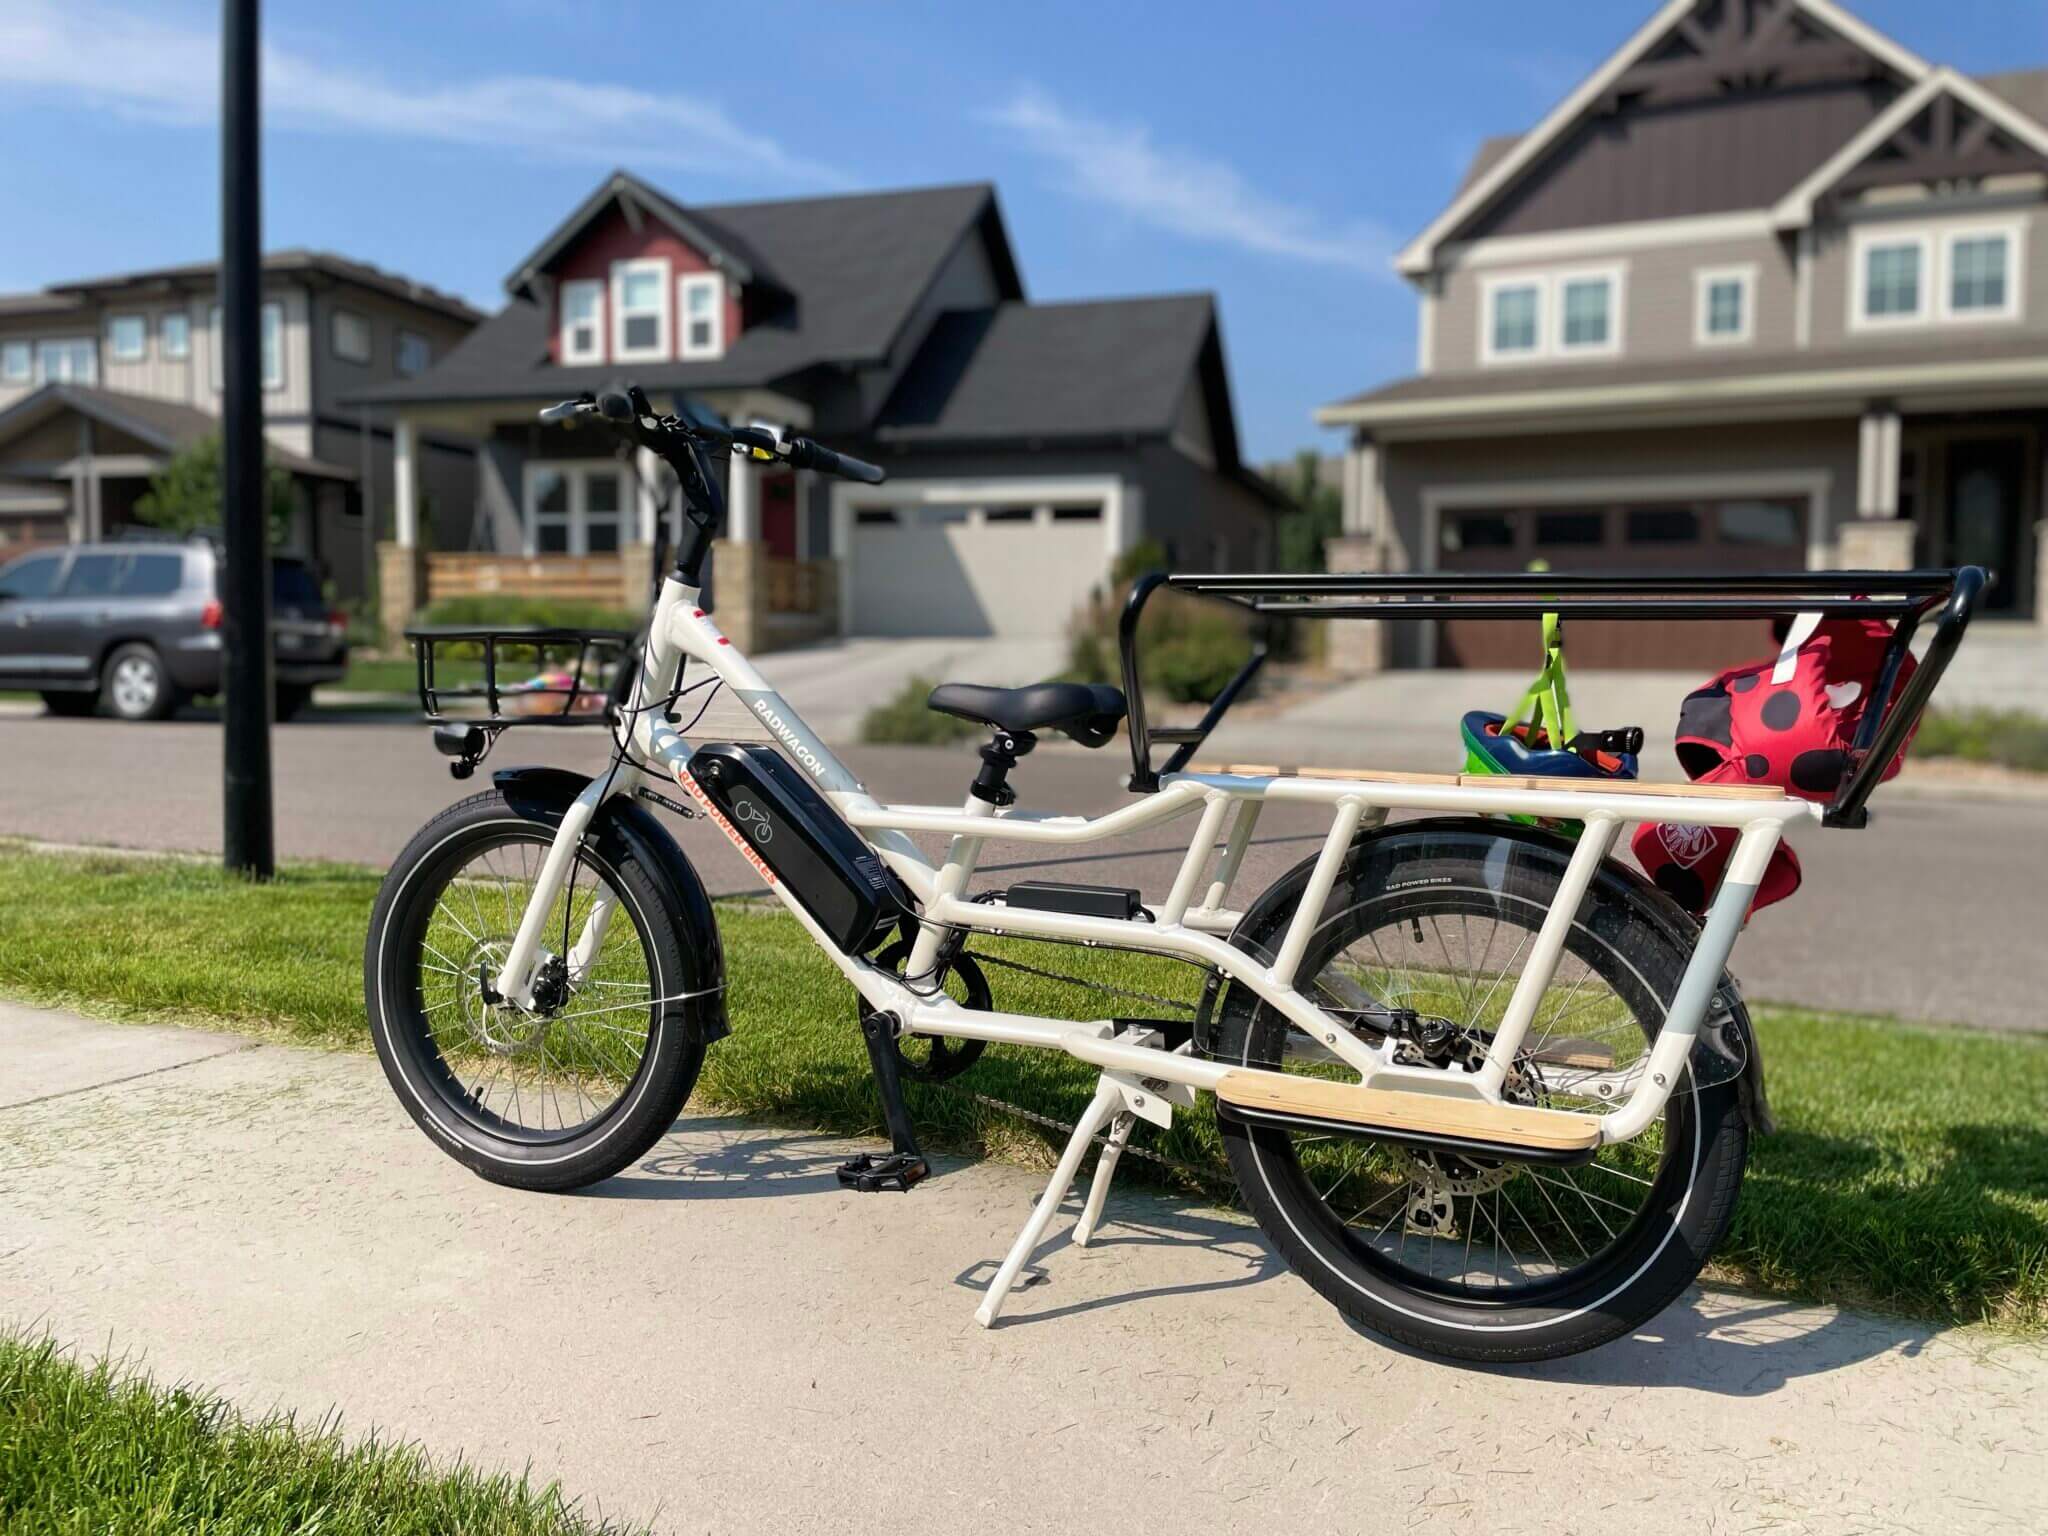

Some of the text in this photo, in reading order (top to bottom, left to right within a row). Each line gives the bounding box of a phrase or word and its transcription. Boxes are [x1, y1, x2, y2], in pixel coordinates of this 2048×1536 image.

[753, 698, 826, 777] RADWAGON
[679, 770, 778, 884] RAD POWER BIKES
[1402, 879, 1429, 887] POWER
